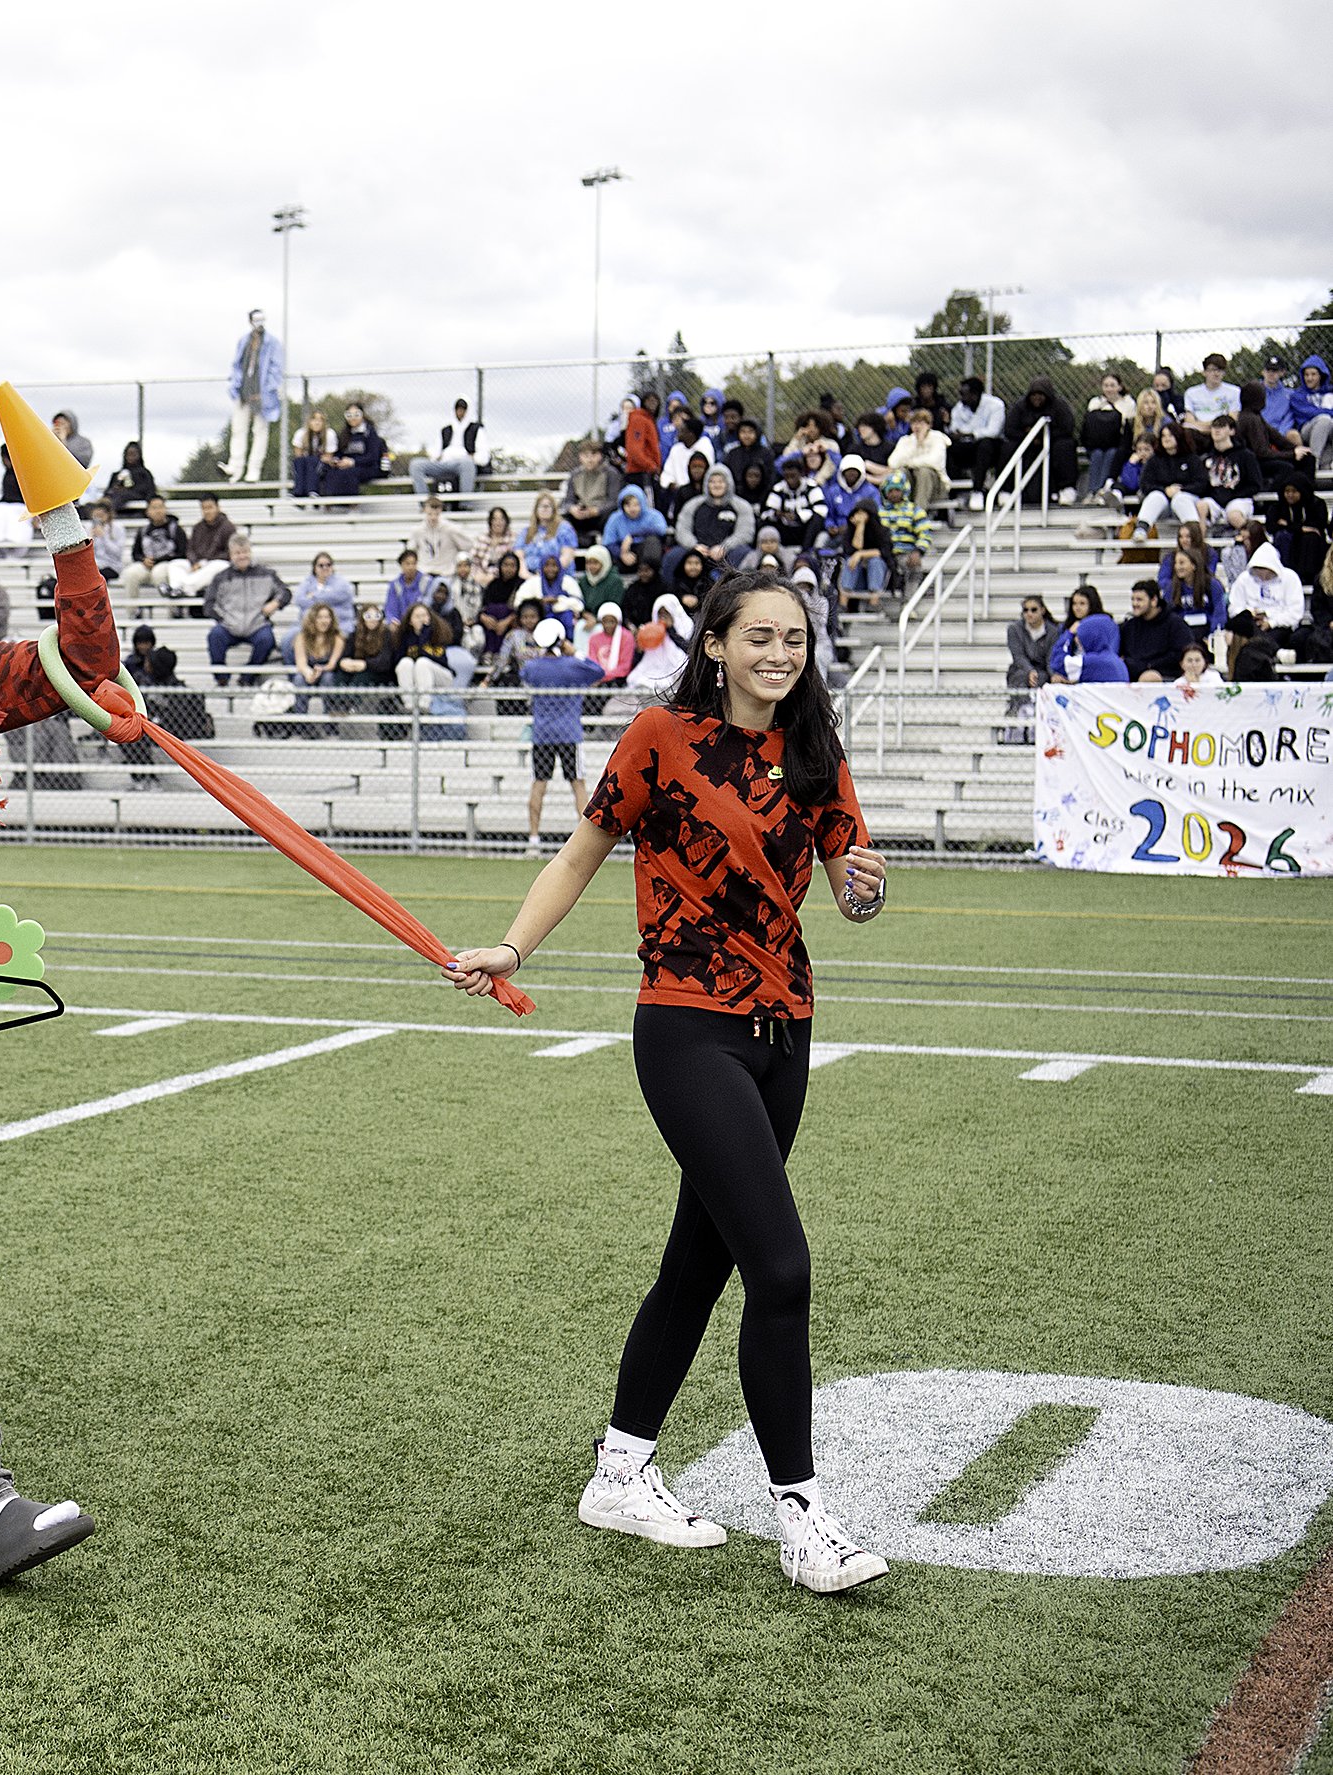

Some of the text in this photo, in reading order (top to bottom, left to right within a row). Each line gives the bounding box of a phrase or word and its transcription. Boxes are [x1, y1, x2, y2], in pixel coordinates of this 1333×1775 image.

[1089, 712, 1331, 767] SOPHOMORE
[1188, 776, 1205, 796] in
[1218, 778, 1260, 803] the
[685, 835, 714, 863] NIKE
[822, 822, 847, 856] NIKE
[1129, 799, 1302, 873] 2026
[715, 968, 746, 991] NIKE
